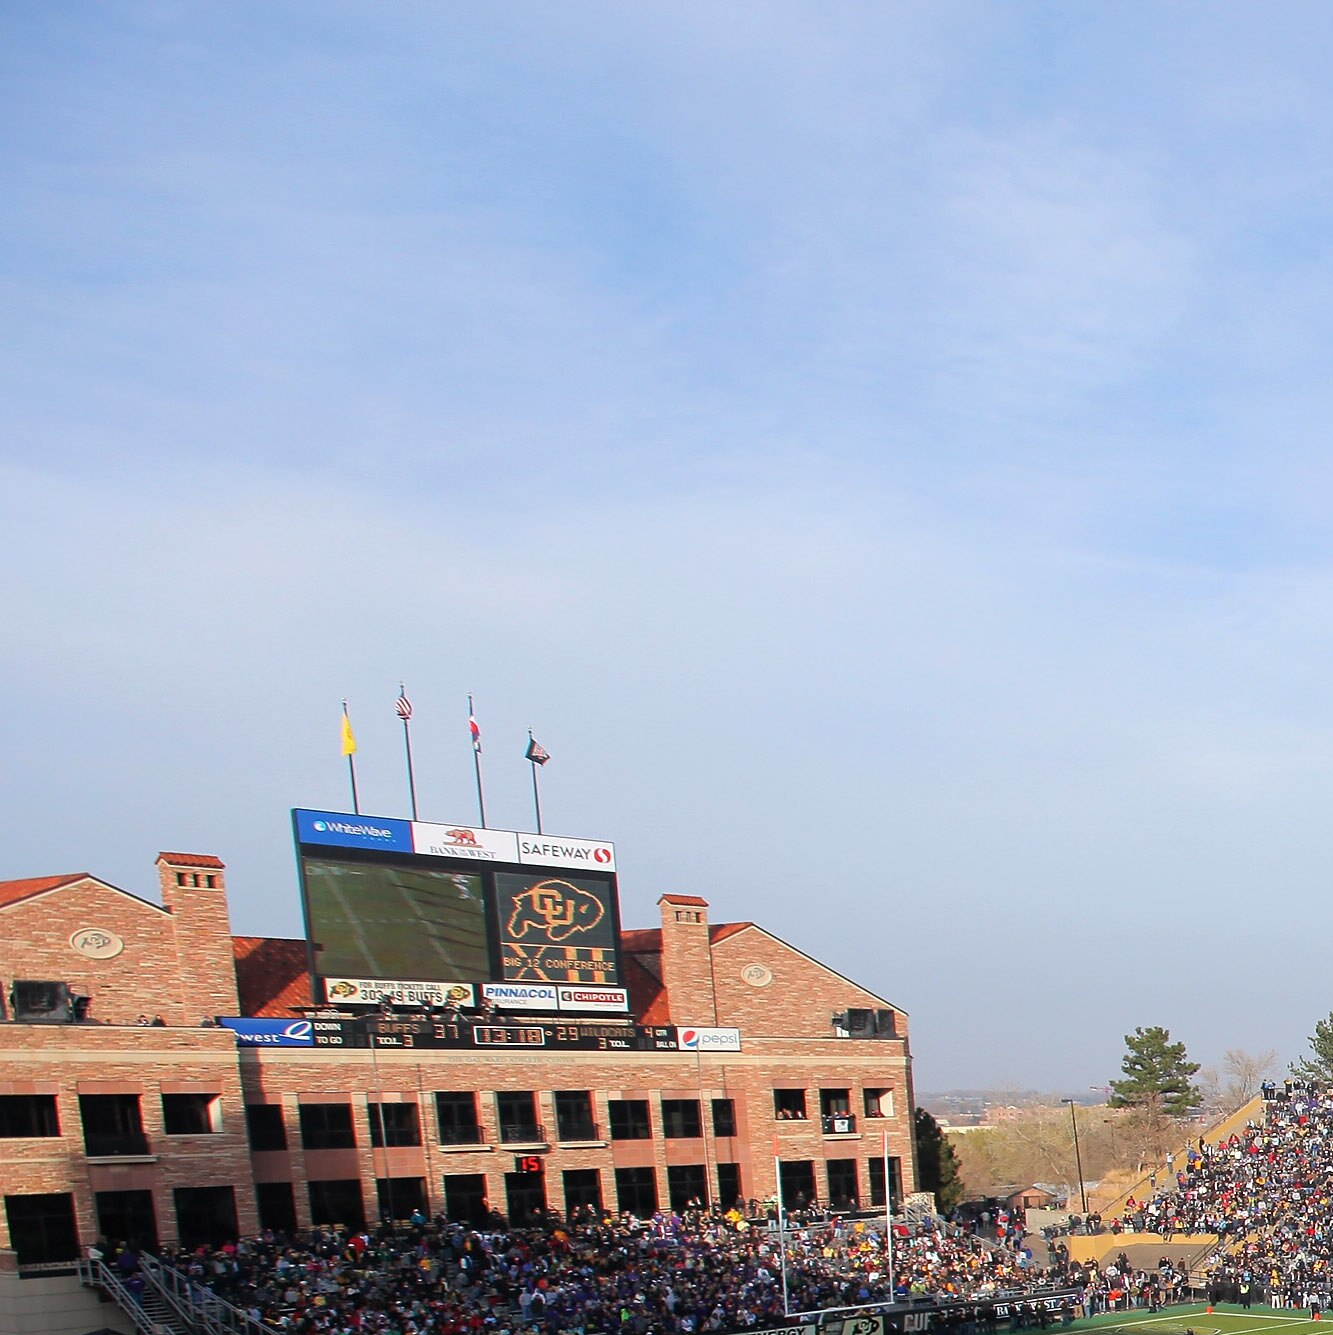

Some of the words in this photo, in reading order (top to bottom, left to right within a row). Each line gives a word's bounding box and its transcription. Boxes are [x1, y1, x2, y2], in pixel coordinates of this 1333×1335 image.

[326, 821, 392, 838] WhiteWave
[430, 846, 455, 856] BANK
[468, 848, 497, 859] WEST
[522, 842, 591, 860] SAFEWAY
[532, 888, 575, 925] CU
[504, 957, 521, 967] BIG
[527, 958, 540, 968] 12
[545, 959, 615, 971] CONFERENCE
[486, 987, 555, 998] PINNACOL
[575, 993, 623, 1001] CHIPOTLE
[315, 1023, 341, 1031] DOWN
[378, 1023, 420, 1034] BUFFS
[433, 1024, 459, 1039] 37
[580, 1028, 635, 1038] WILDCATS
[645, 1028, 653, 1038] 4
[330, 1036, 343, 1044] GO
[483, 1028, 541, 1043] 13:18
[556, 1027, 578, 1041] 29
[702, 1033, 738, 1046] pepsi
[403, 1035, 413, 1047] 3
[599, 1038, 607, 1049] 3
[522, 1157, 540, 1172] 15
